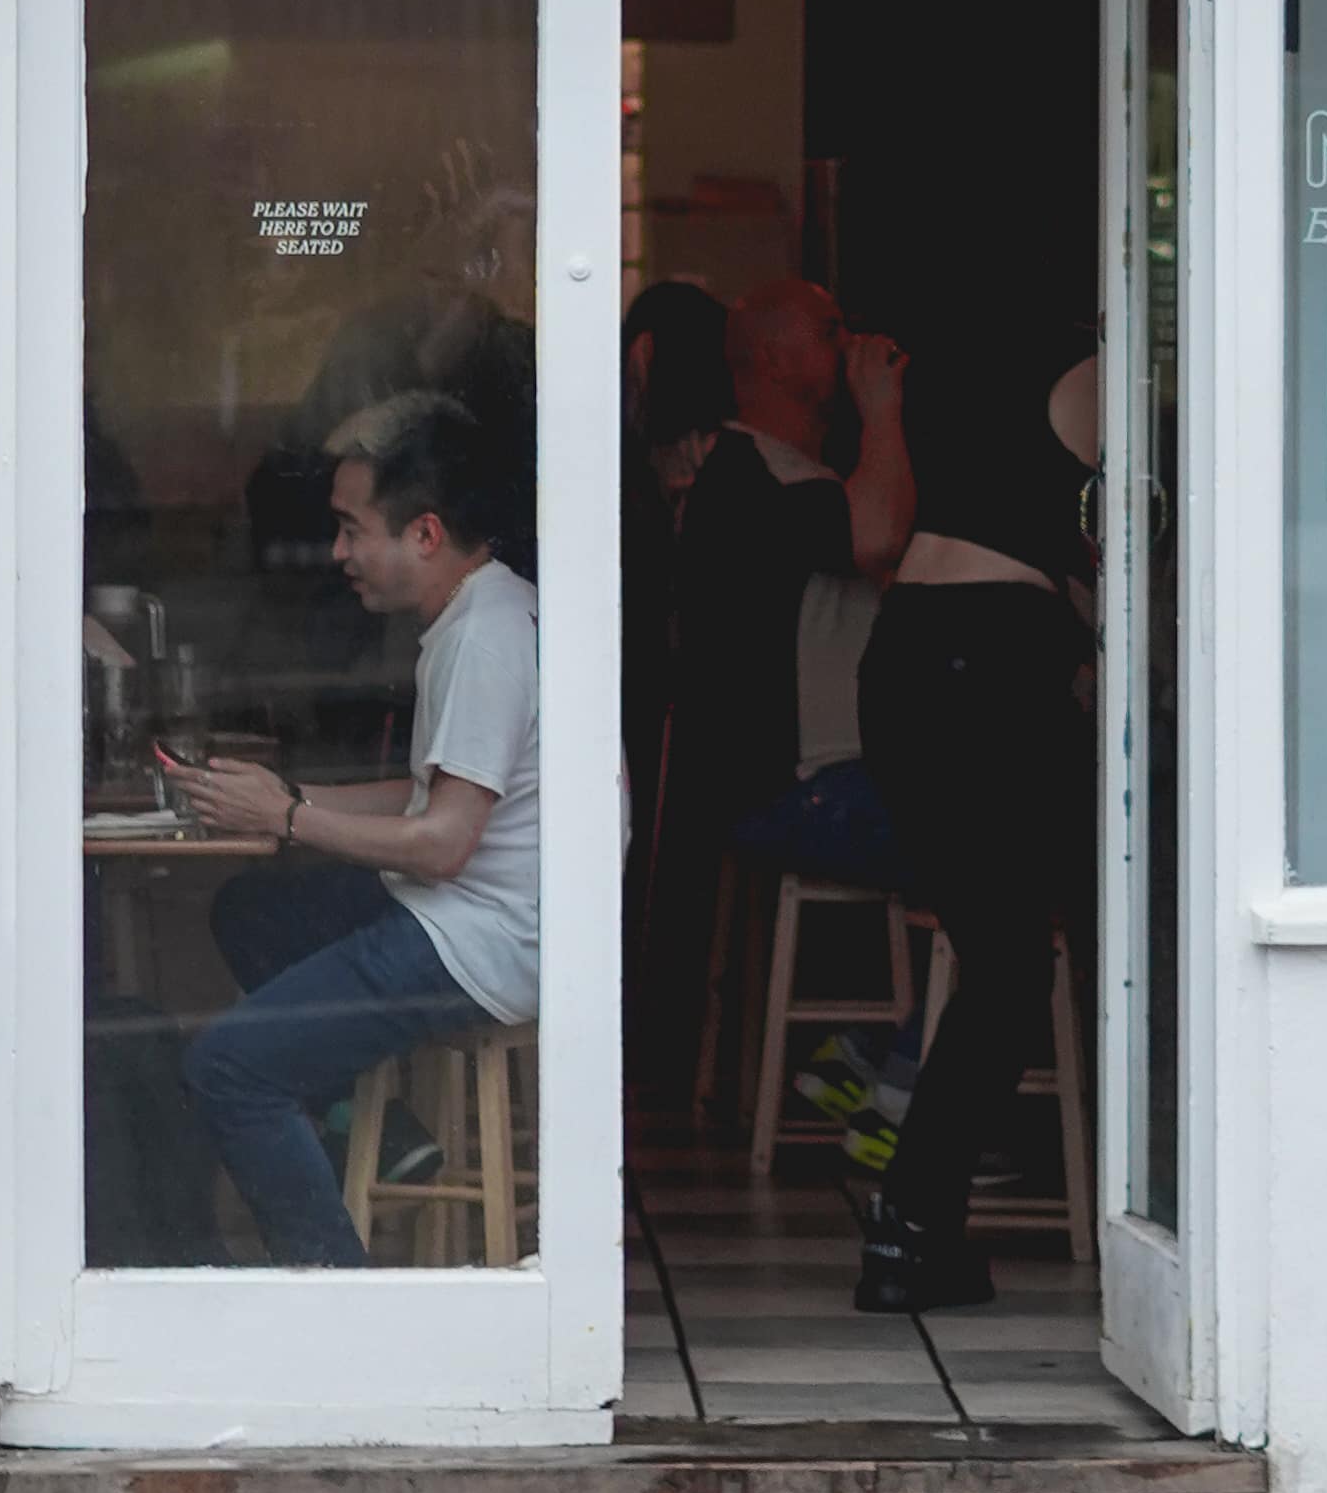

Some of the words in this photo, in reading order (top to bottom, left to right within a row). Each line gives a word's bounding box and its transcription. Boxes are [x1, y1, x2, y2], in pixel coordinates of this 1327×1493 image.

[253, 201, 320, 217] PLEASE
[322, 201, 368, 217] WAIT
[259, 220, 308, 236] HERE
[310, 220, 335, 236] TO
[336, 220, 361, 236] BE
[275, 239, 344, 255] SEATED
